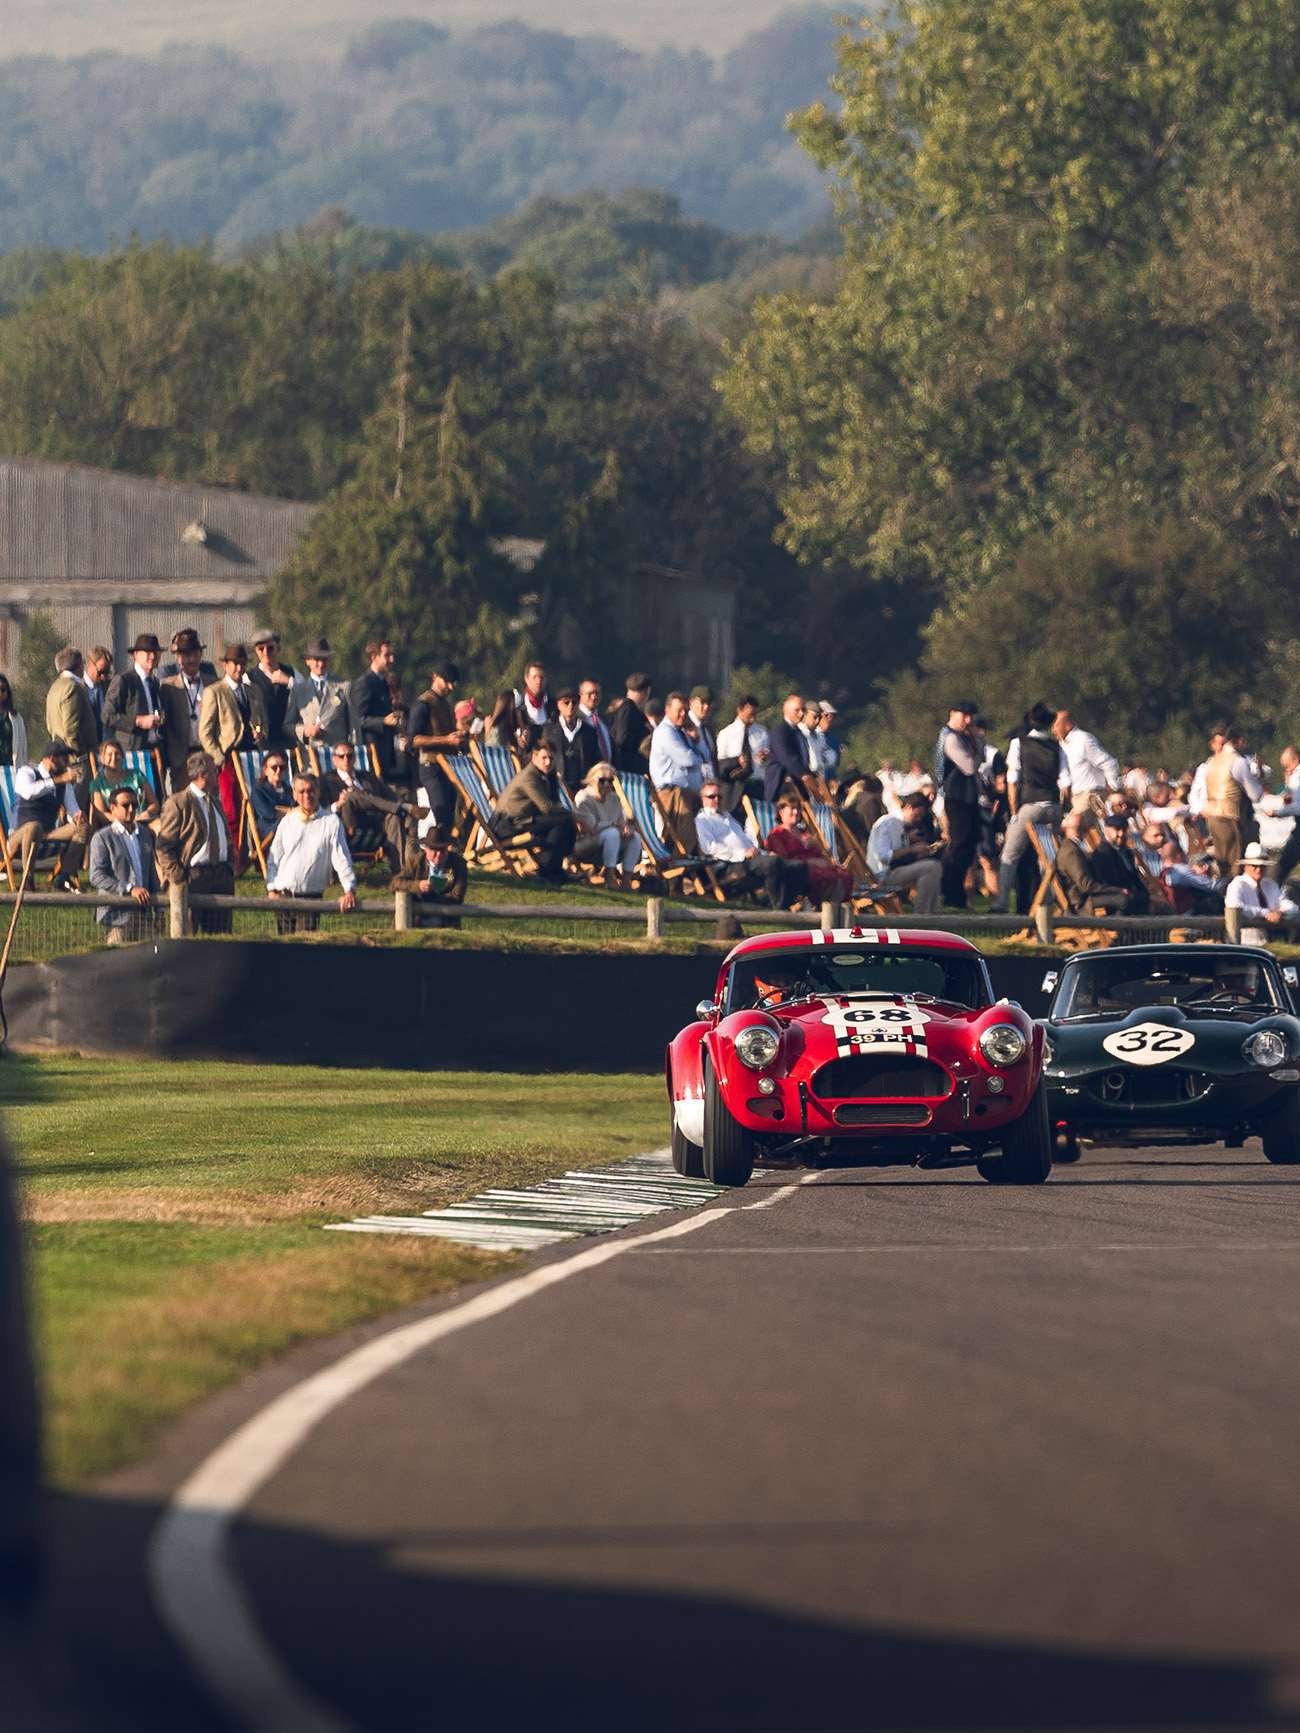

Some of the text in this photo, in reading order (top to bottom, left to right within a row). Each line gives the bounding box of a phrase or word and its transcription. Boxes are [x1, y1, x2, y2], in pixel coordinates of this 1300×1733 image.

[843, 1008, 912, 1022] 68
[850, 1034, 913, 1044] 39 PH
[1116, 1030, 1184, 1052] 32
